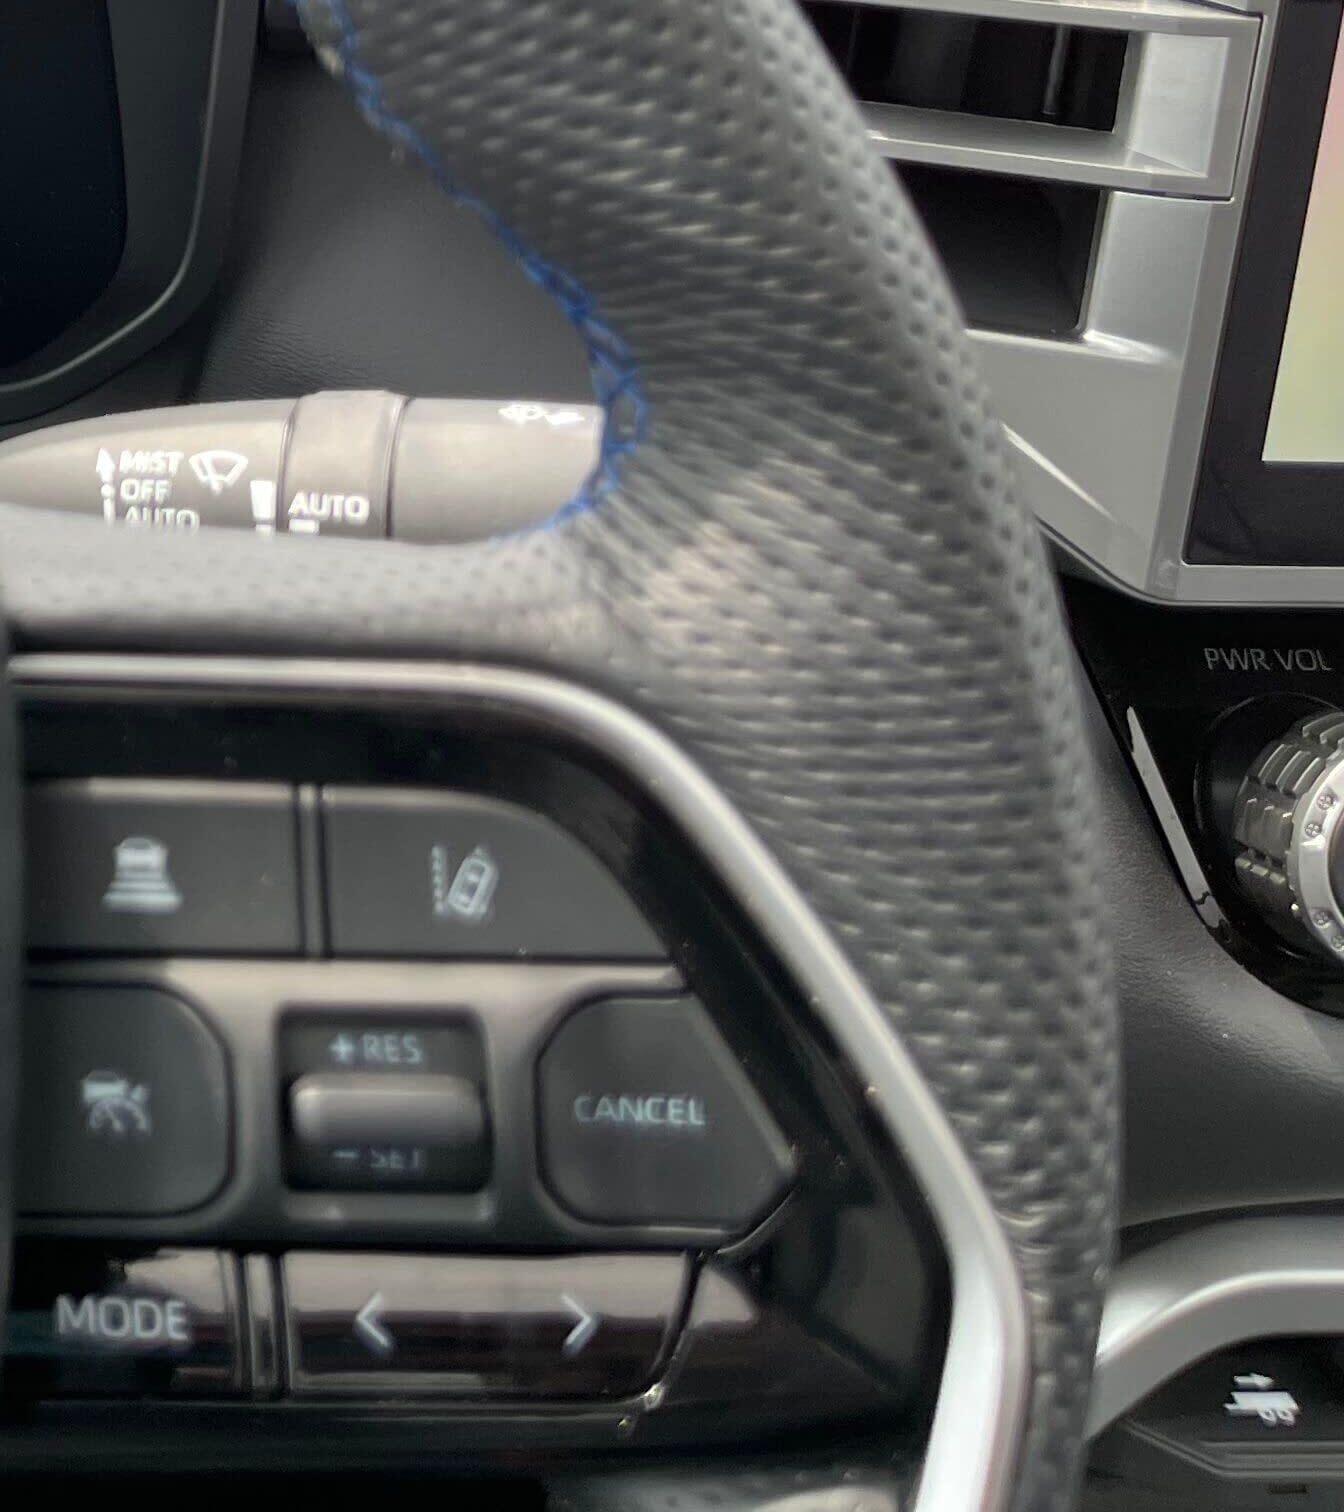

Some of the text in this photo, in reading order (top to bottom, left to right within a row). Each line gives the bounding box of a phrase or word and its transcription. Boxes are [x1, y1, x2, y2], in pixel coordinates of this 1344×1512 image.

[119, 449, 184, 475] MIST
[120, 478, 172, 503] OFF
[125, 505, 200, 531] AUTO
[288, 493, 370, 519] AUTO
[1203, 647, 1333, 671] PWR VOL
[574, 1095, 706, 1127] CANCEL
[55, 1294, 189, 1343] MODE
